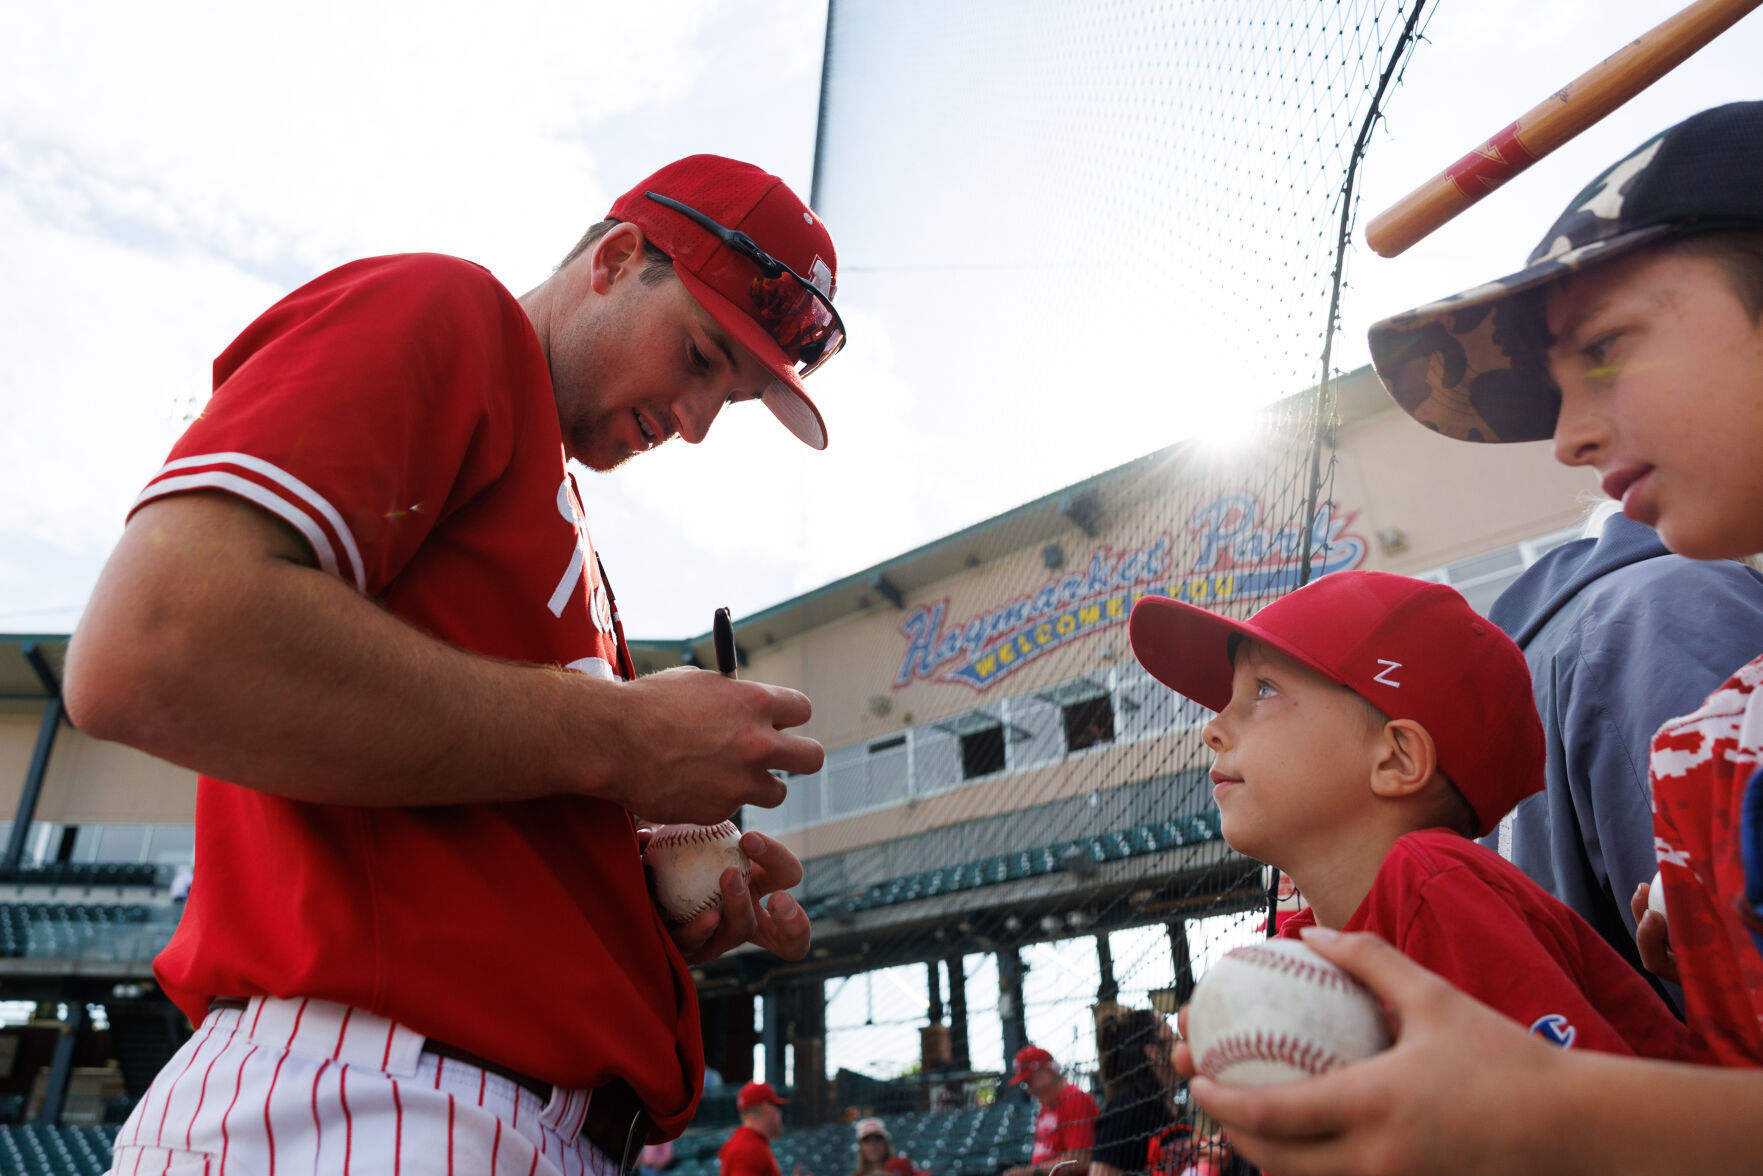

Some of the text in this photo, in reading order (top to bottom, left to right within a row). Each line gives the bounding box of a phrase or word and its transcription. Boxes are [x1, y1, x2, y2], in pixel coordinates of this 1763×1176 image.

[893, 489, 1367, 690] Haymarket Park
[1168, 575, 1234, 601] YOU
